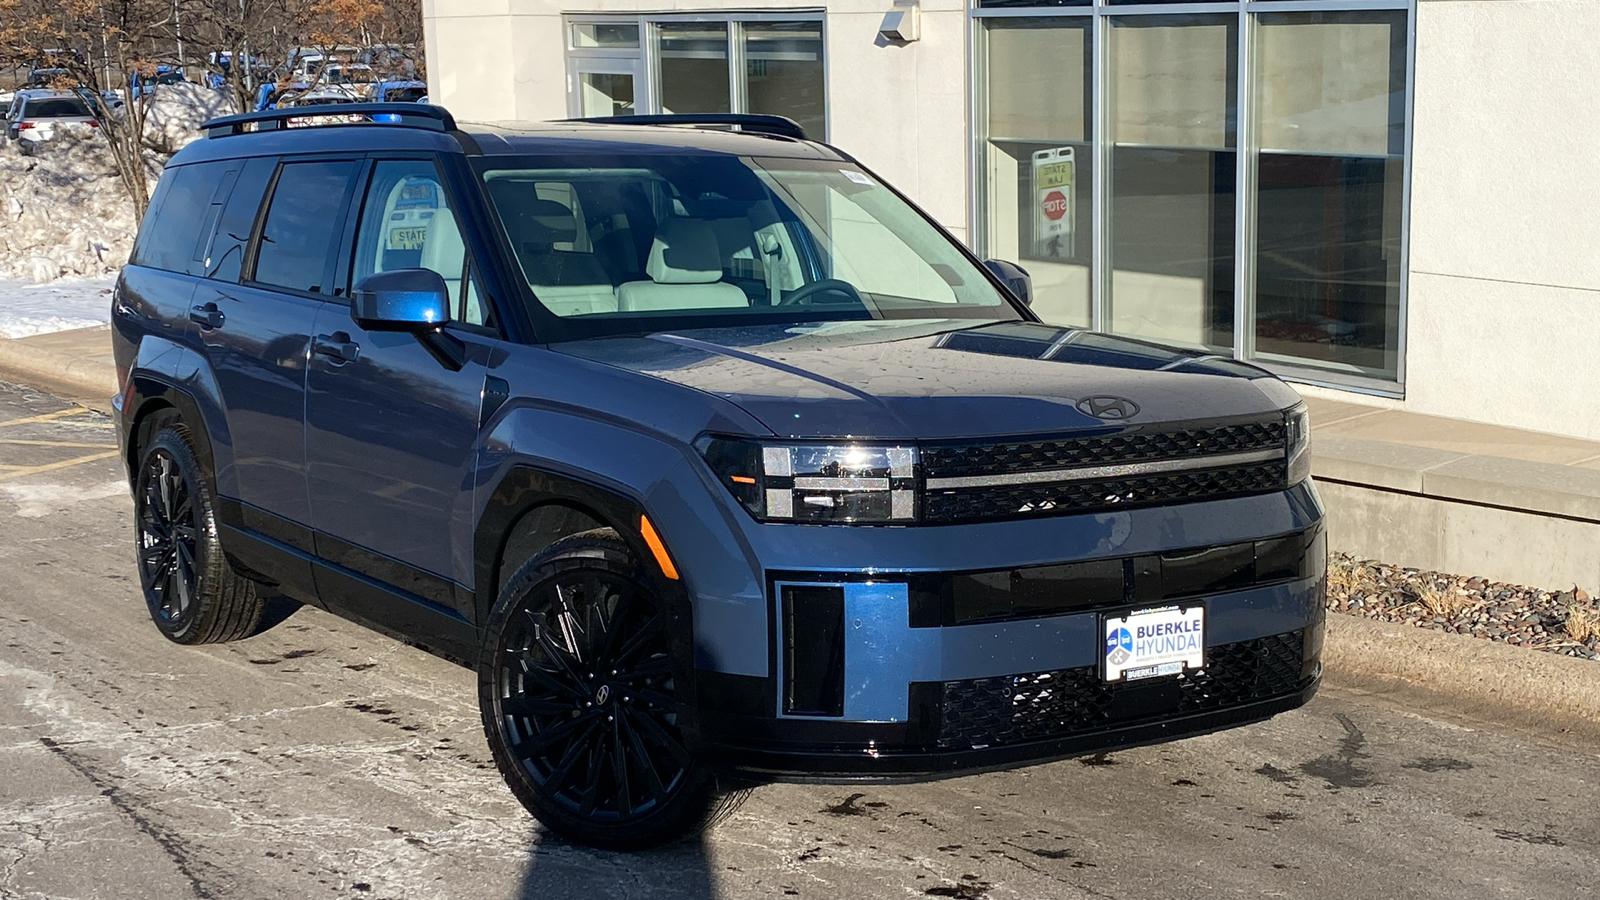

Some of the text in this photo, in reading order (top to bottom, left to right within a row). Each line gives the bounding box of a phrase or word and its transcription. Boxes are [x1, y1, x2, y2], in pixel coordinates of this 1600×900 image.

[399, 230, 426, 240] STATE
[1137, 620, 1200, 638] BUERKLE
[1136, 633, 1200, 656] HYUNDAI
[1128, 667, 1158, 678] BUERKLE
